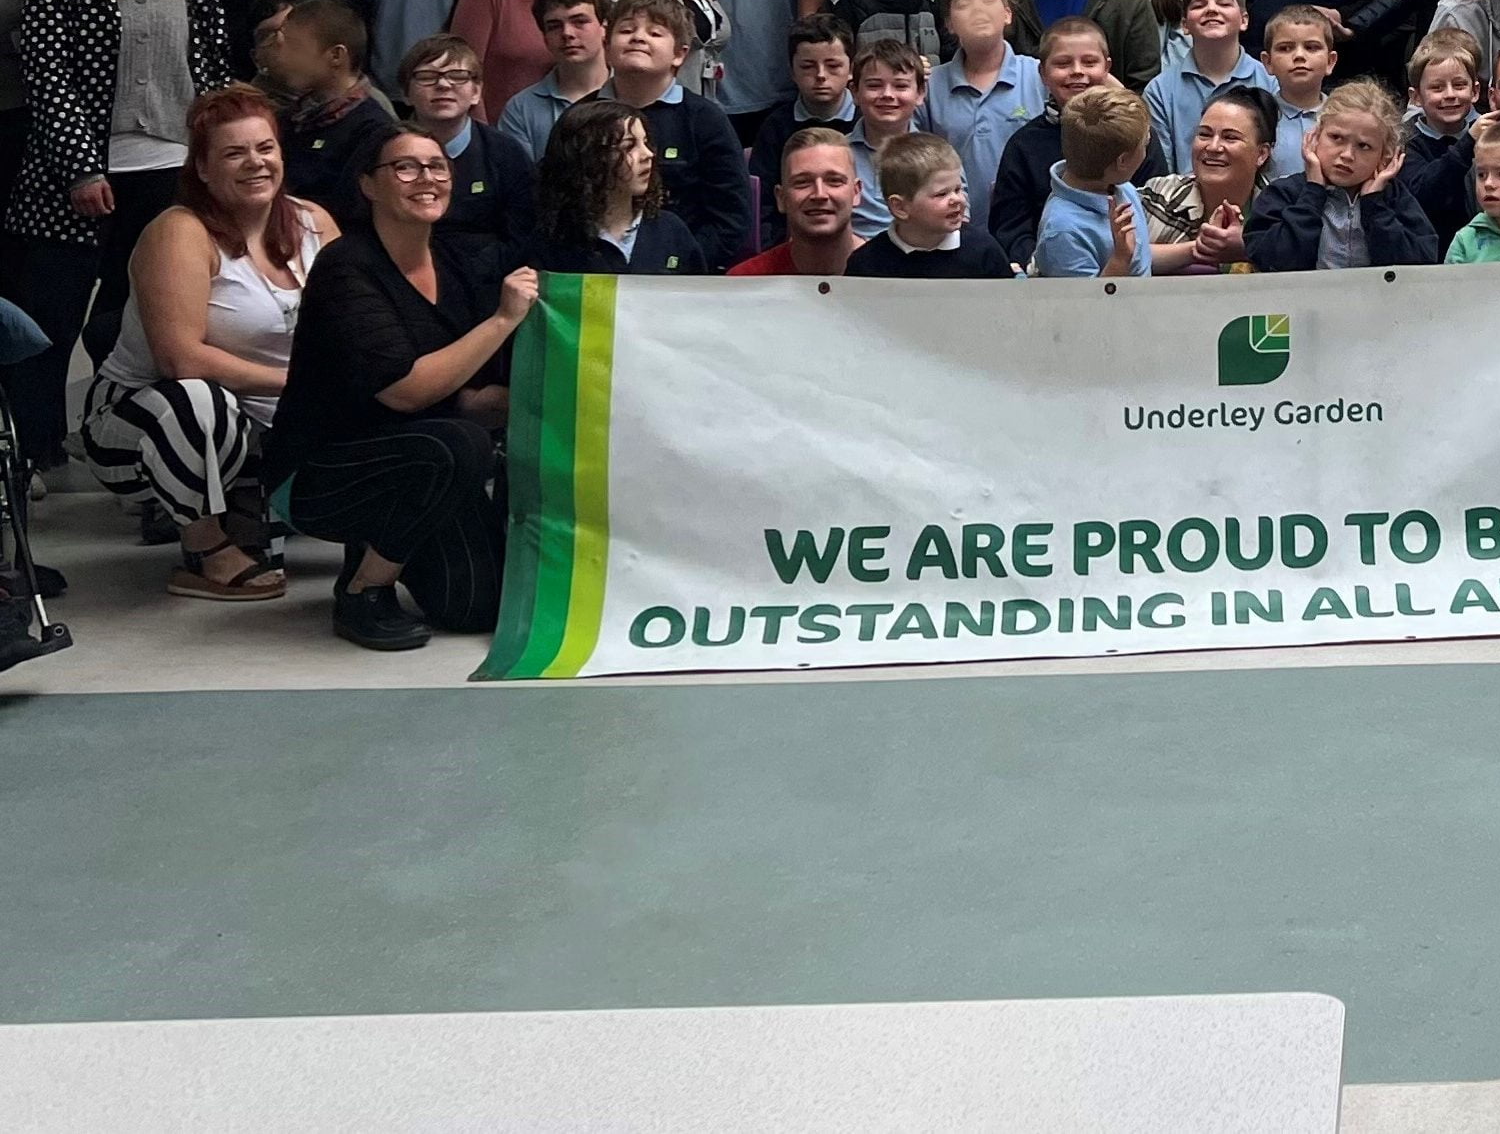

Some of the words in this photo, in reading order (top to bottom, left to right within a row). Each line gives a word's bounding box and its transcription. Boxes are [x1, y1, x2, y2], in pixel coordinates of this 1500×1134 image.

[1124, 403, 1265, 432] Underley
[1273, 398, 1383, 425] Garden
[764, 526, 890, 584] WE
[906, 522, 1054, 581] ARE
[1073, 514, 1328, 576] PROUD
[1344, 510, 1442, 566] TO
[629, 592, 1186, 649] OUTSTANDING
[1211, 589, 1284, 626] IN
[1301, 583, 1436, 621] ALL
